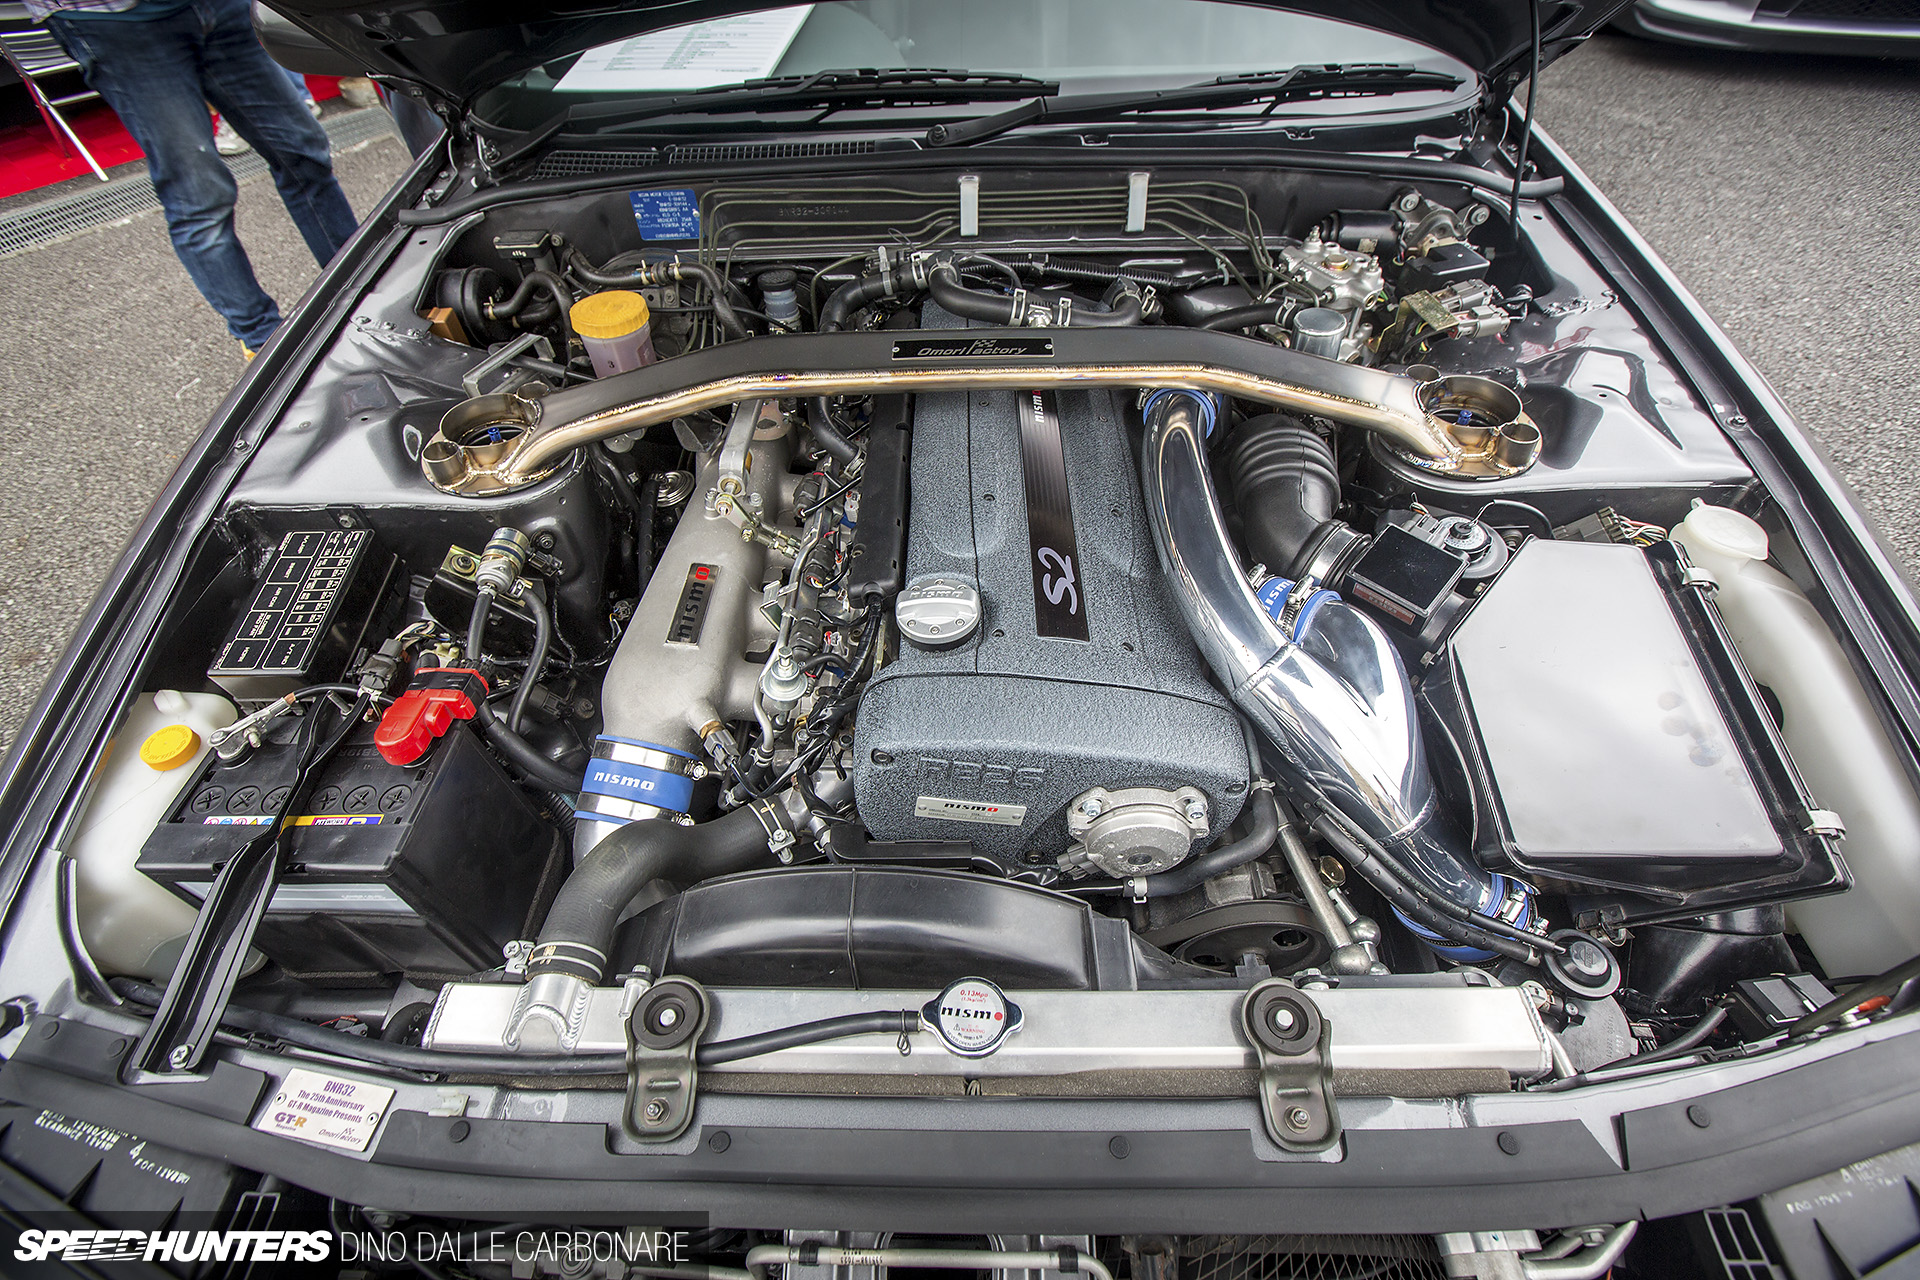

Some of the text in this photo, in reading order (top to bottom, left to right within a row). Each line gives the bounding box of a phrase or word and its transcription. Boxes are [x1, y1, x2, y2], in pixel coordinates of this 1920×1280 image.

[1037, 547, 1077, 615] S2
[677, 566, 710, 639] nismo
[593, 772, 655, 791] nismo
[944, 803, 999, 812] nismo
[323, 1080, 356, 1097] BNR32
[287, 1099, 362, 1123] GT-R Magazine Presents
[298, 1089, 365, 1112] The 25th Anniversary
[274, 1112, 307, 1128] GT-R
